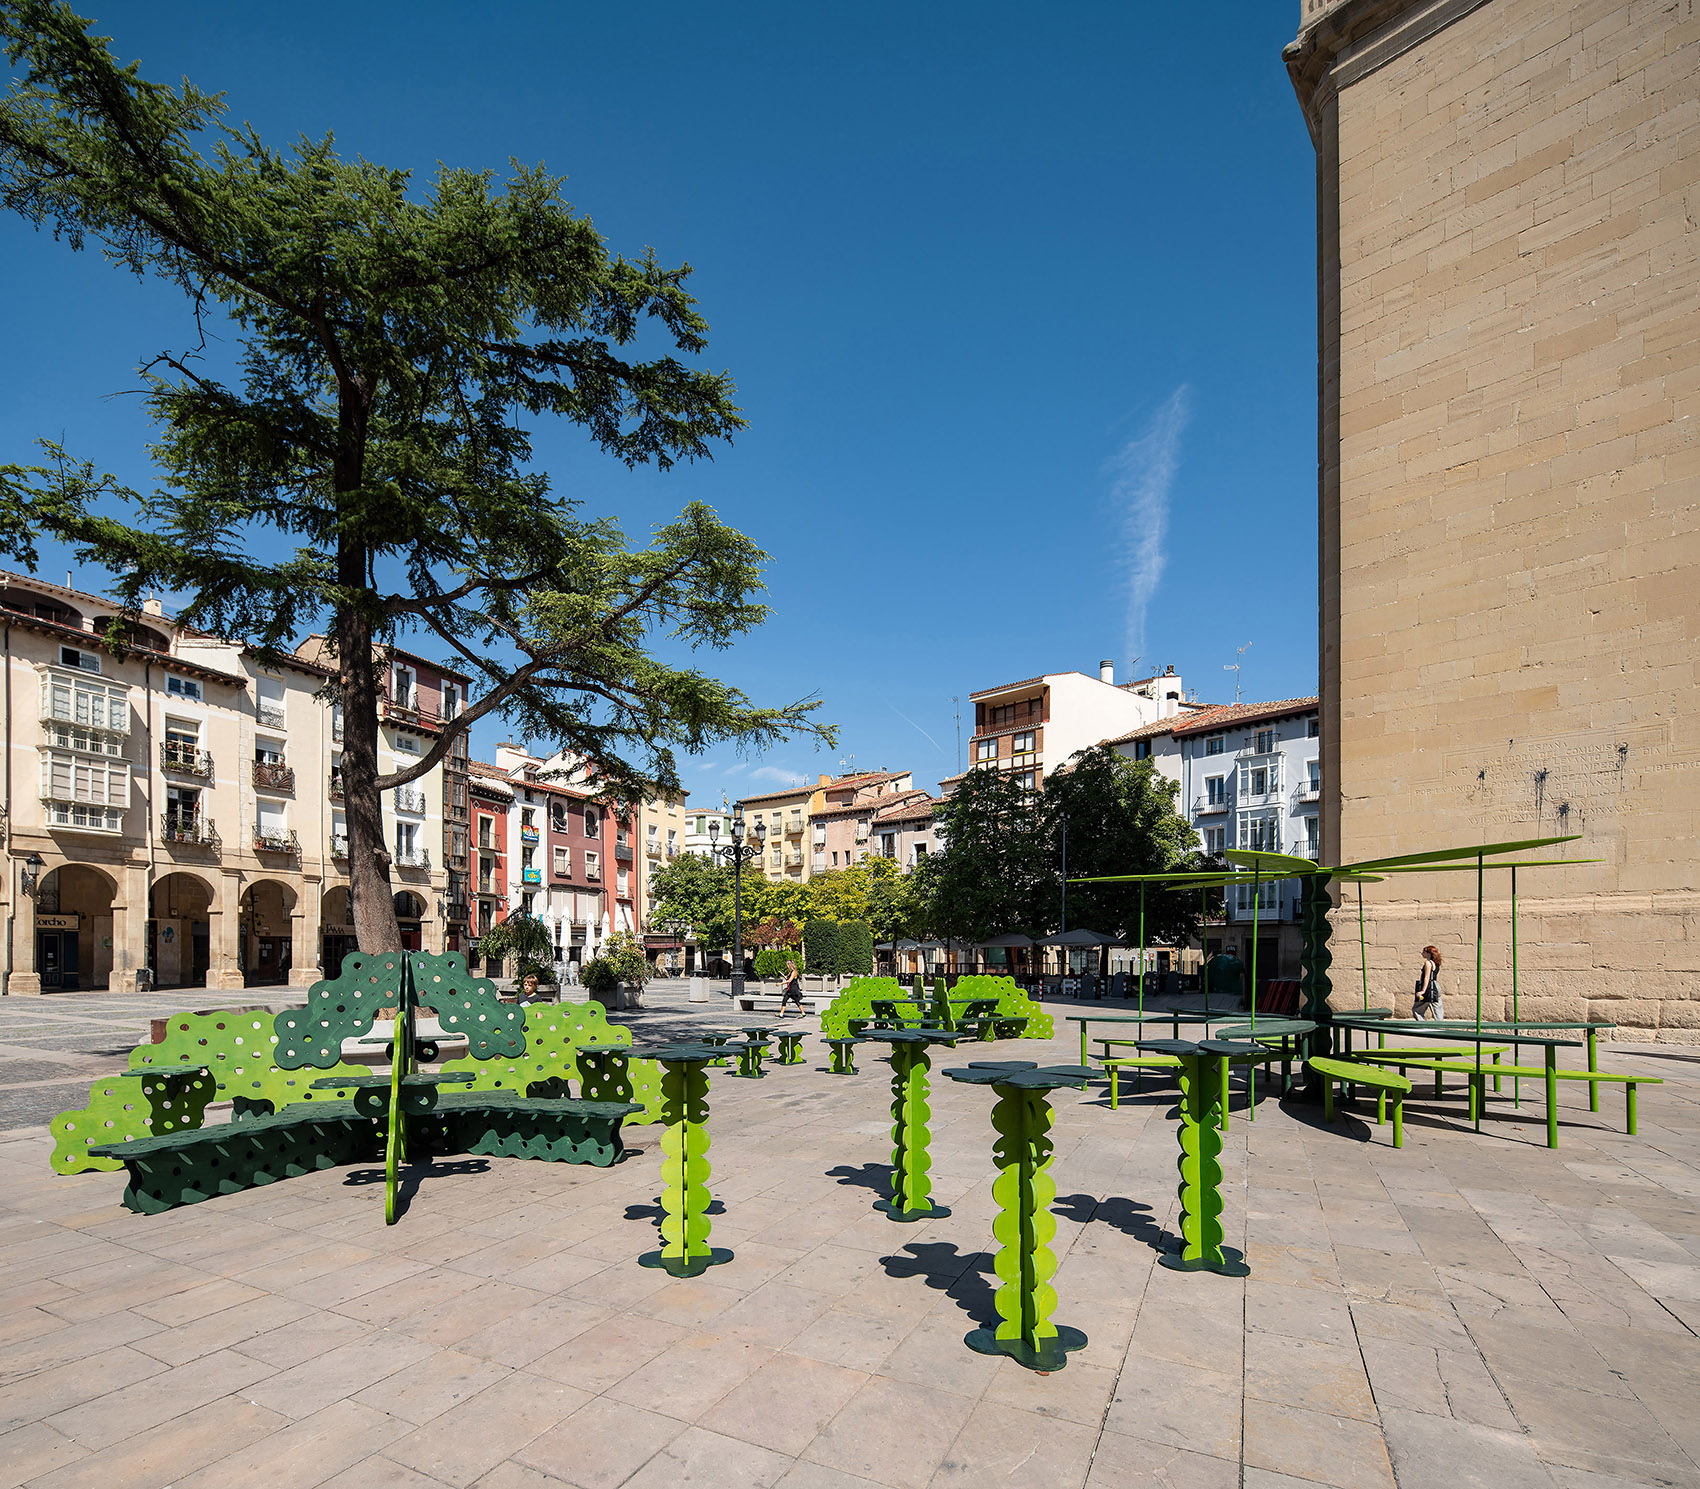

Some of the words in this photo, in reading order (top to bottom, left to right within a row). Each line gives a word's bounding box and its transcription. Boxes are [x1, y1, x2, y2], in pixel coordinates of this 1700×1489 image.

[1528, 741, 1568, 752] ESPAÑA
[1475, 753, 1534, 766] VENCEDORA
[1538, 750, 1557, 759] DEL
[1565, 742, 1627, 756] COMUNISM
[1477, 763, 1523, 774] RUZADA
[1528, 761, 1548, 770] QUE
[1553, 754, 1601, 767] LEVANTO
[1607, 749, 1637, 760] ESE
[1554, 766, 1573, 774] DEL
[1580, 760, 1625, 772] IMPER
[1449, 783, 1485, 794] UNIDA
[1573, 777, 1617, 790] FRANCO
